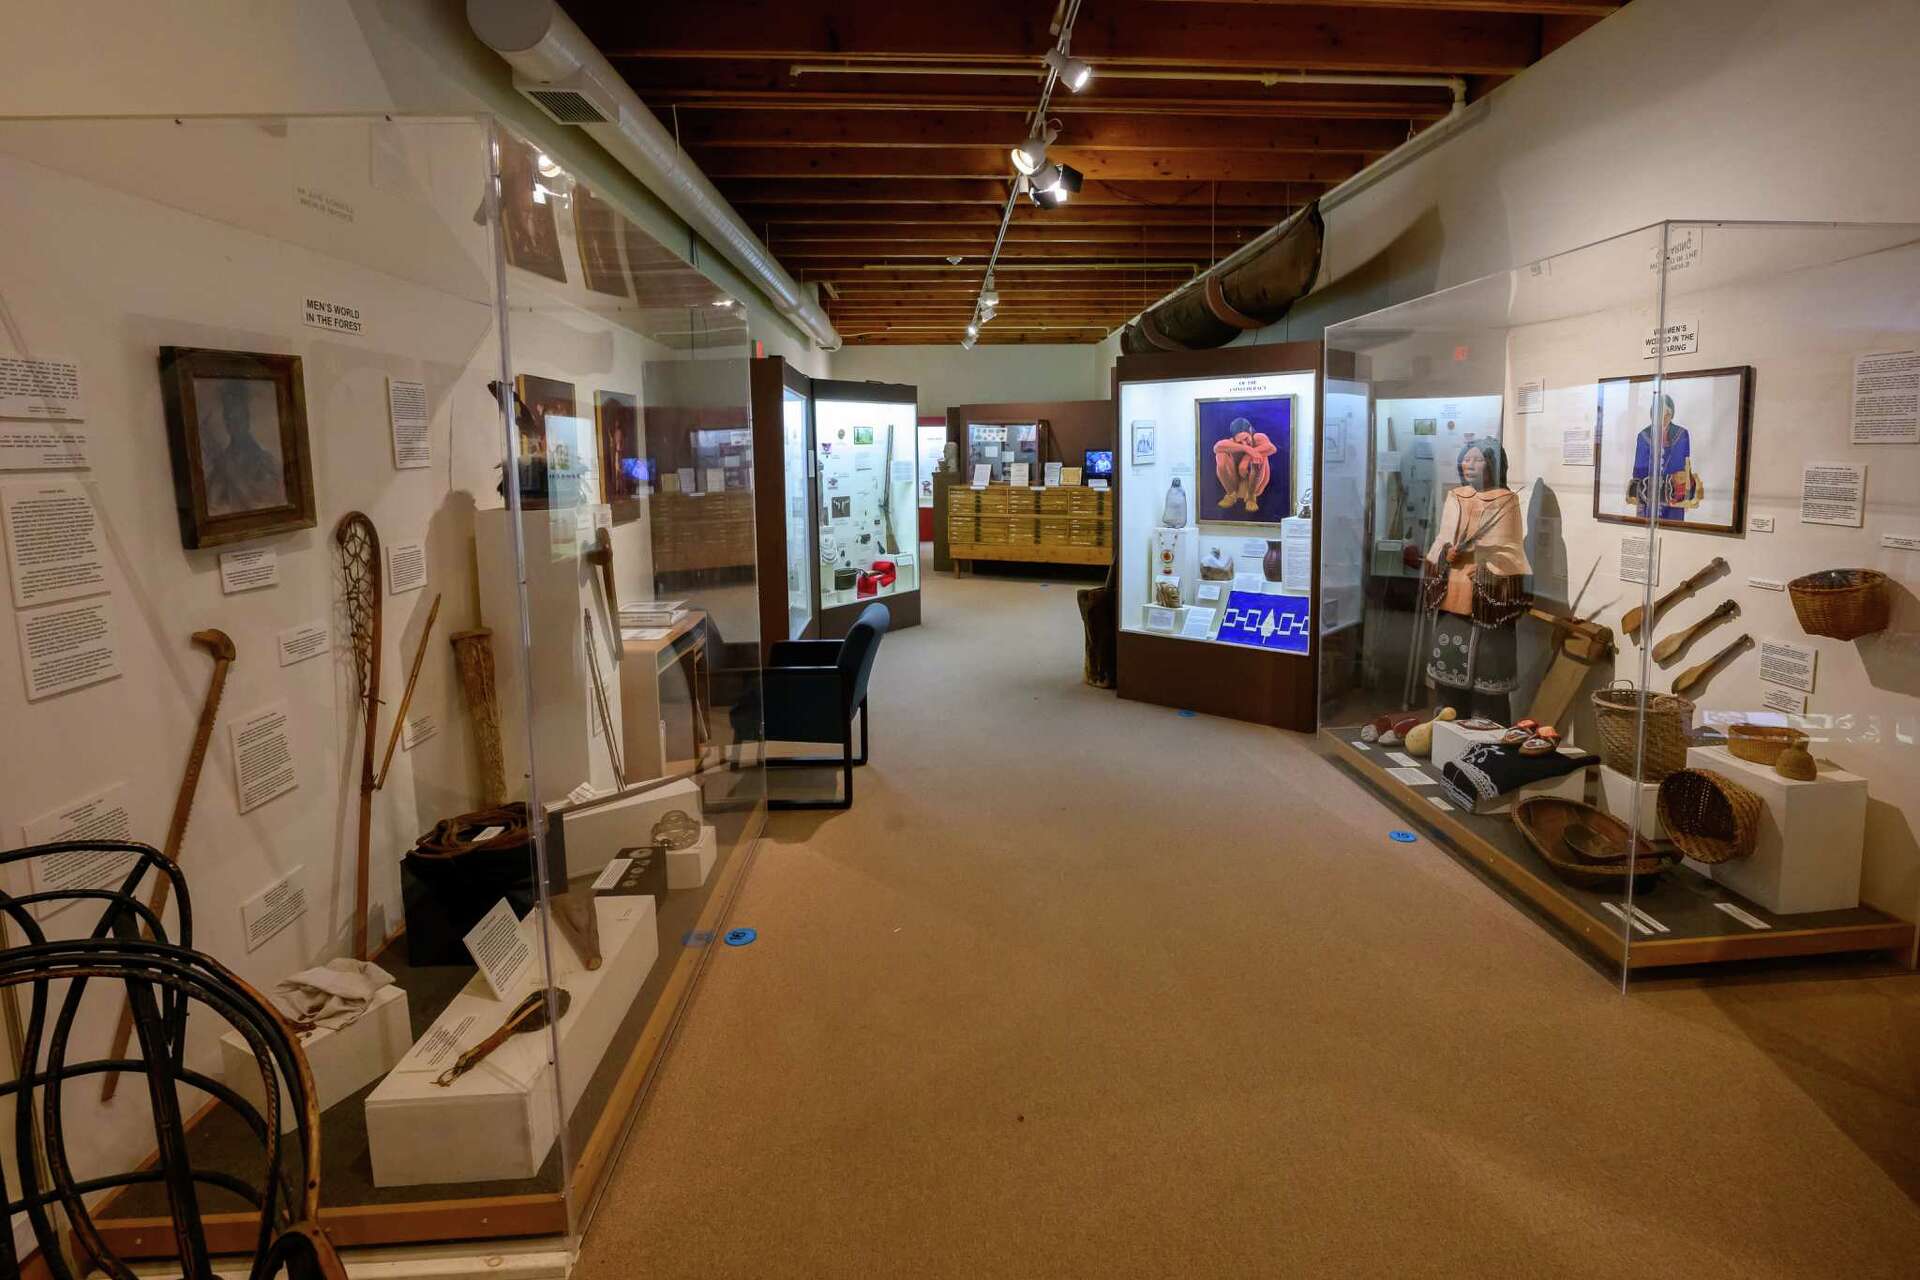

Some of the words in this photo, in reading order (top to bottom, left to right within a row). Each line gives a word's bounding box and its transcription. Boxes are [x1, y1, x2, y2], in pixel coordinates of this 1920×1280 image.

[306, 299, 332, 312] MEN'S
[334, 305, 360, 320] WORLD
[306, 312, 315, 322] IN
[316, 314, 333, 326] THE
[334, 318, 361, 332] FOREST
[1645, 336, 1671, 346] WOD
[1681, 332, 1695, 341] THE
